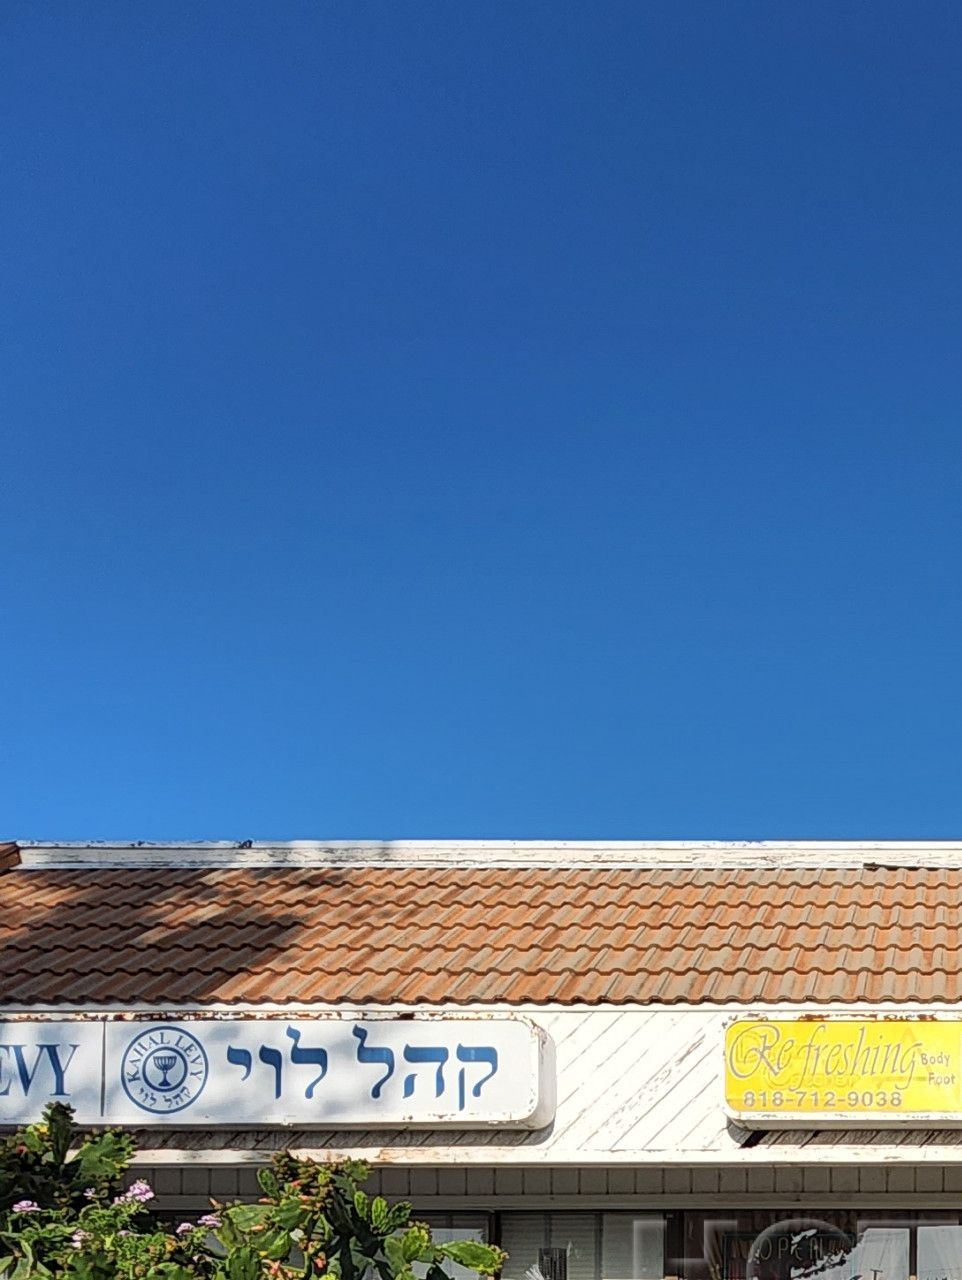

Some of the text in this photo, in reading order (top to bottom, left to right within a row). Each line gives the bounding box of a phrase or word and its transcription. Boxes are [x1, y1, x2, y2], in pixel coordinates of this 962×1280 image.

[127, 1032, 203, 1083] KAHAL LEVY
[921, 1051, 950, 1066] Body
[227, 1024, 498, 1111] קהל לוי
[928, 1072, 955, 1085] Foot
[743, 1091, 902, 1107] 818-712-9038
